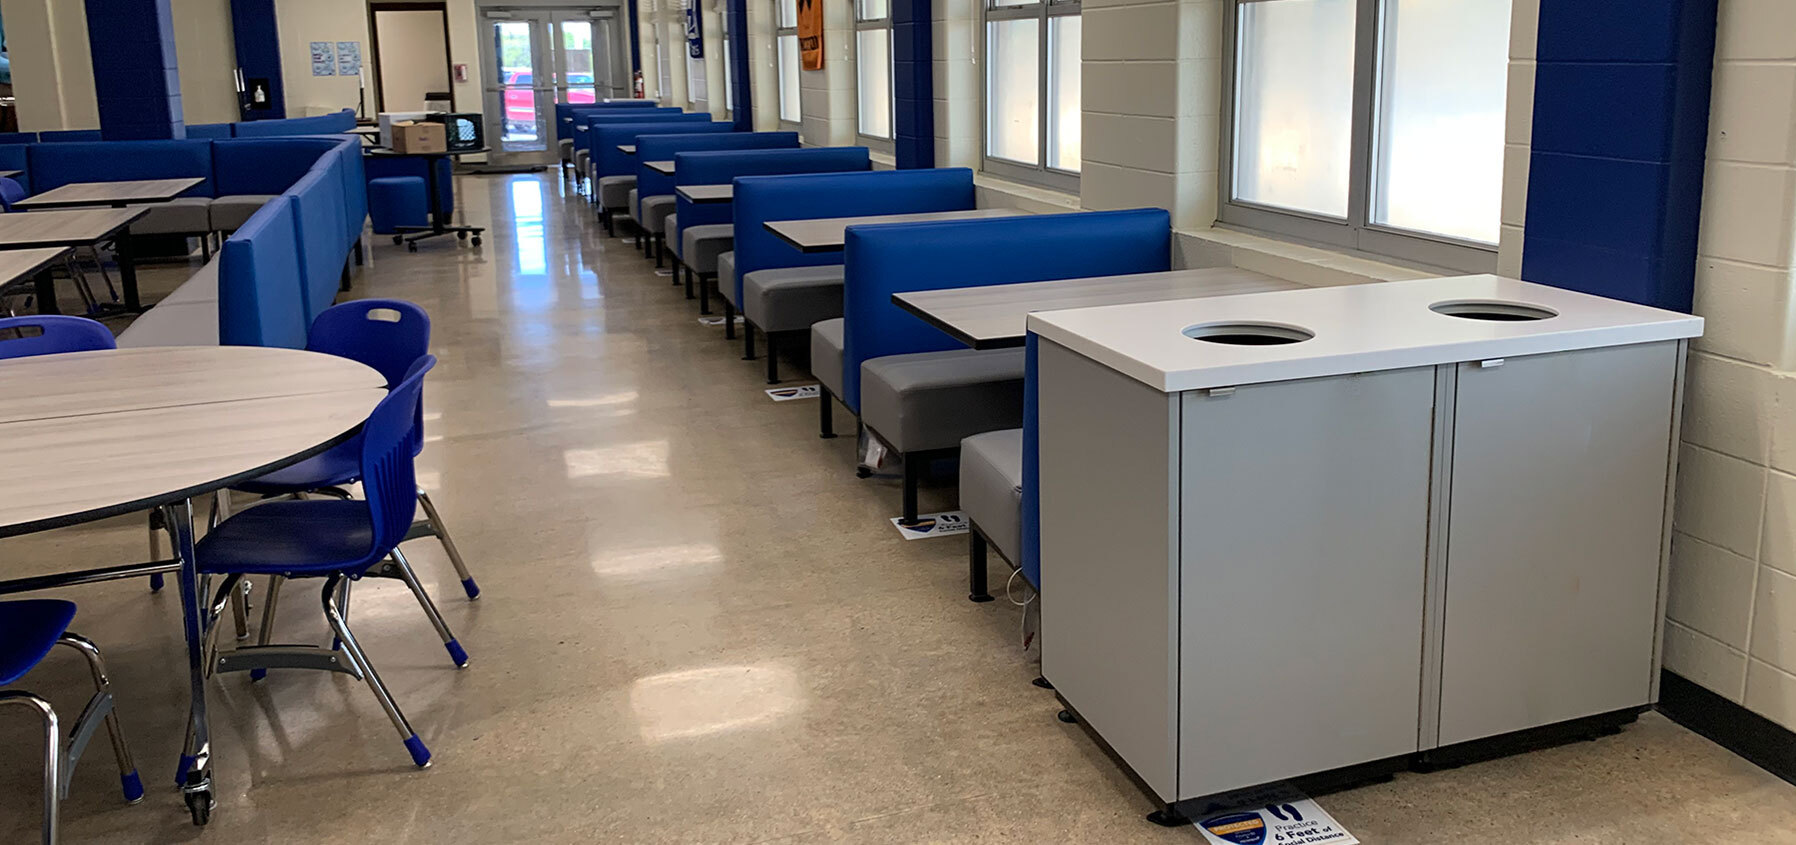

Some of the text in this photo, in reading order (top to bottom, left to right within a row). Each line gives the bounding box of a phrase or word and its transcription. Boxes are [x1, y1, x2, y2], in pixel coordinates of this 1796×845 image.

[1275, 819, 1318, 831] Practice
[1286, 828, 1320, 838] Feet
[1305, 833, 1344, 842] Distance
